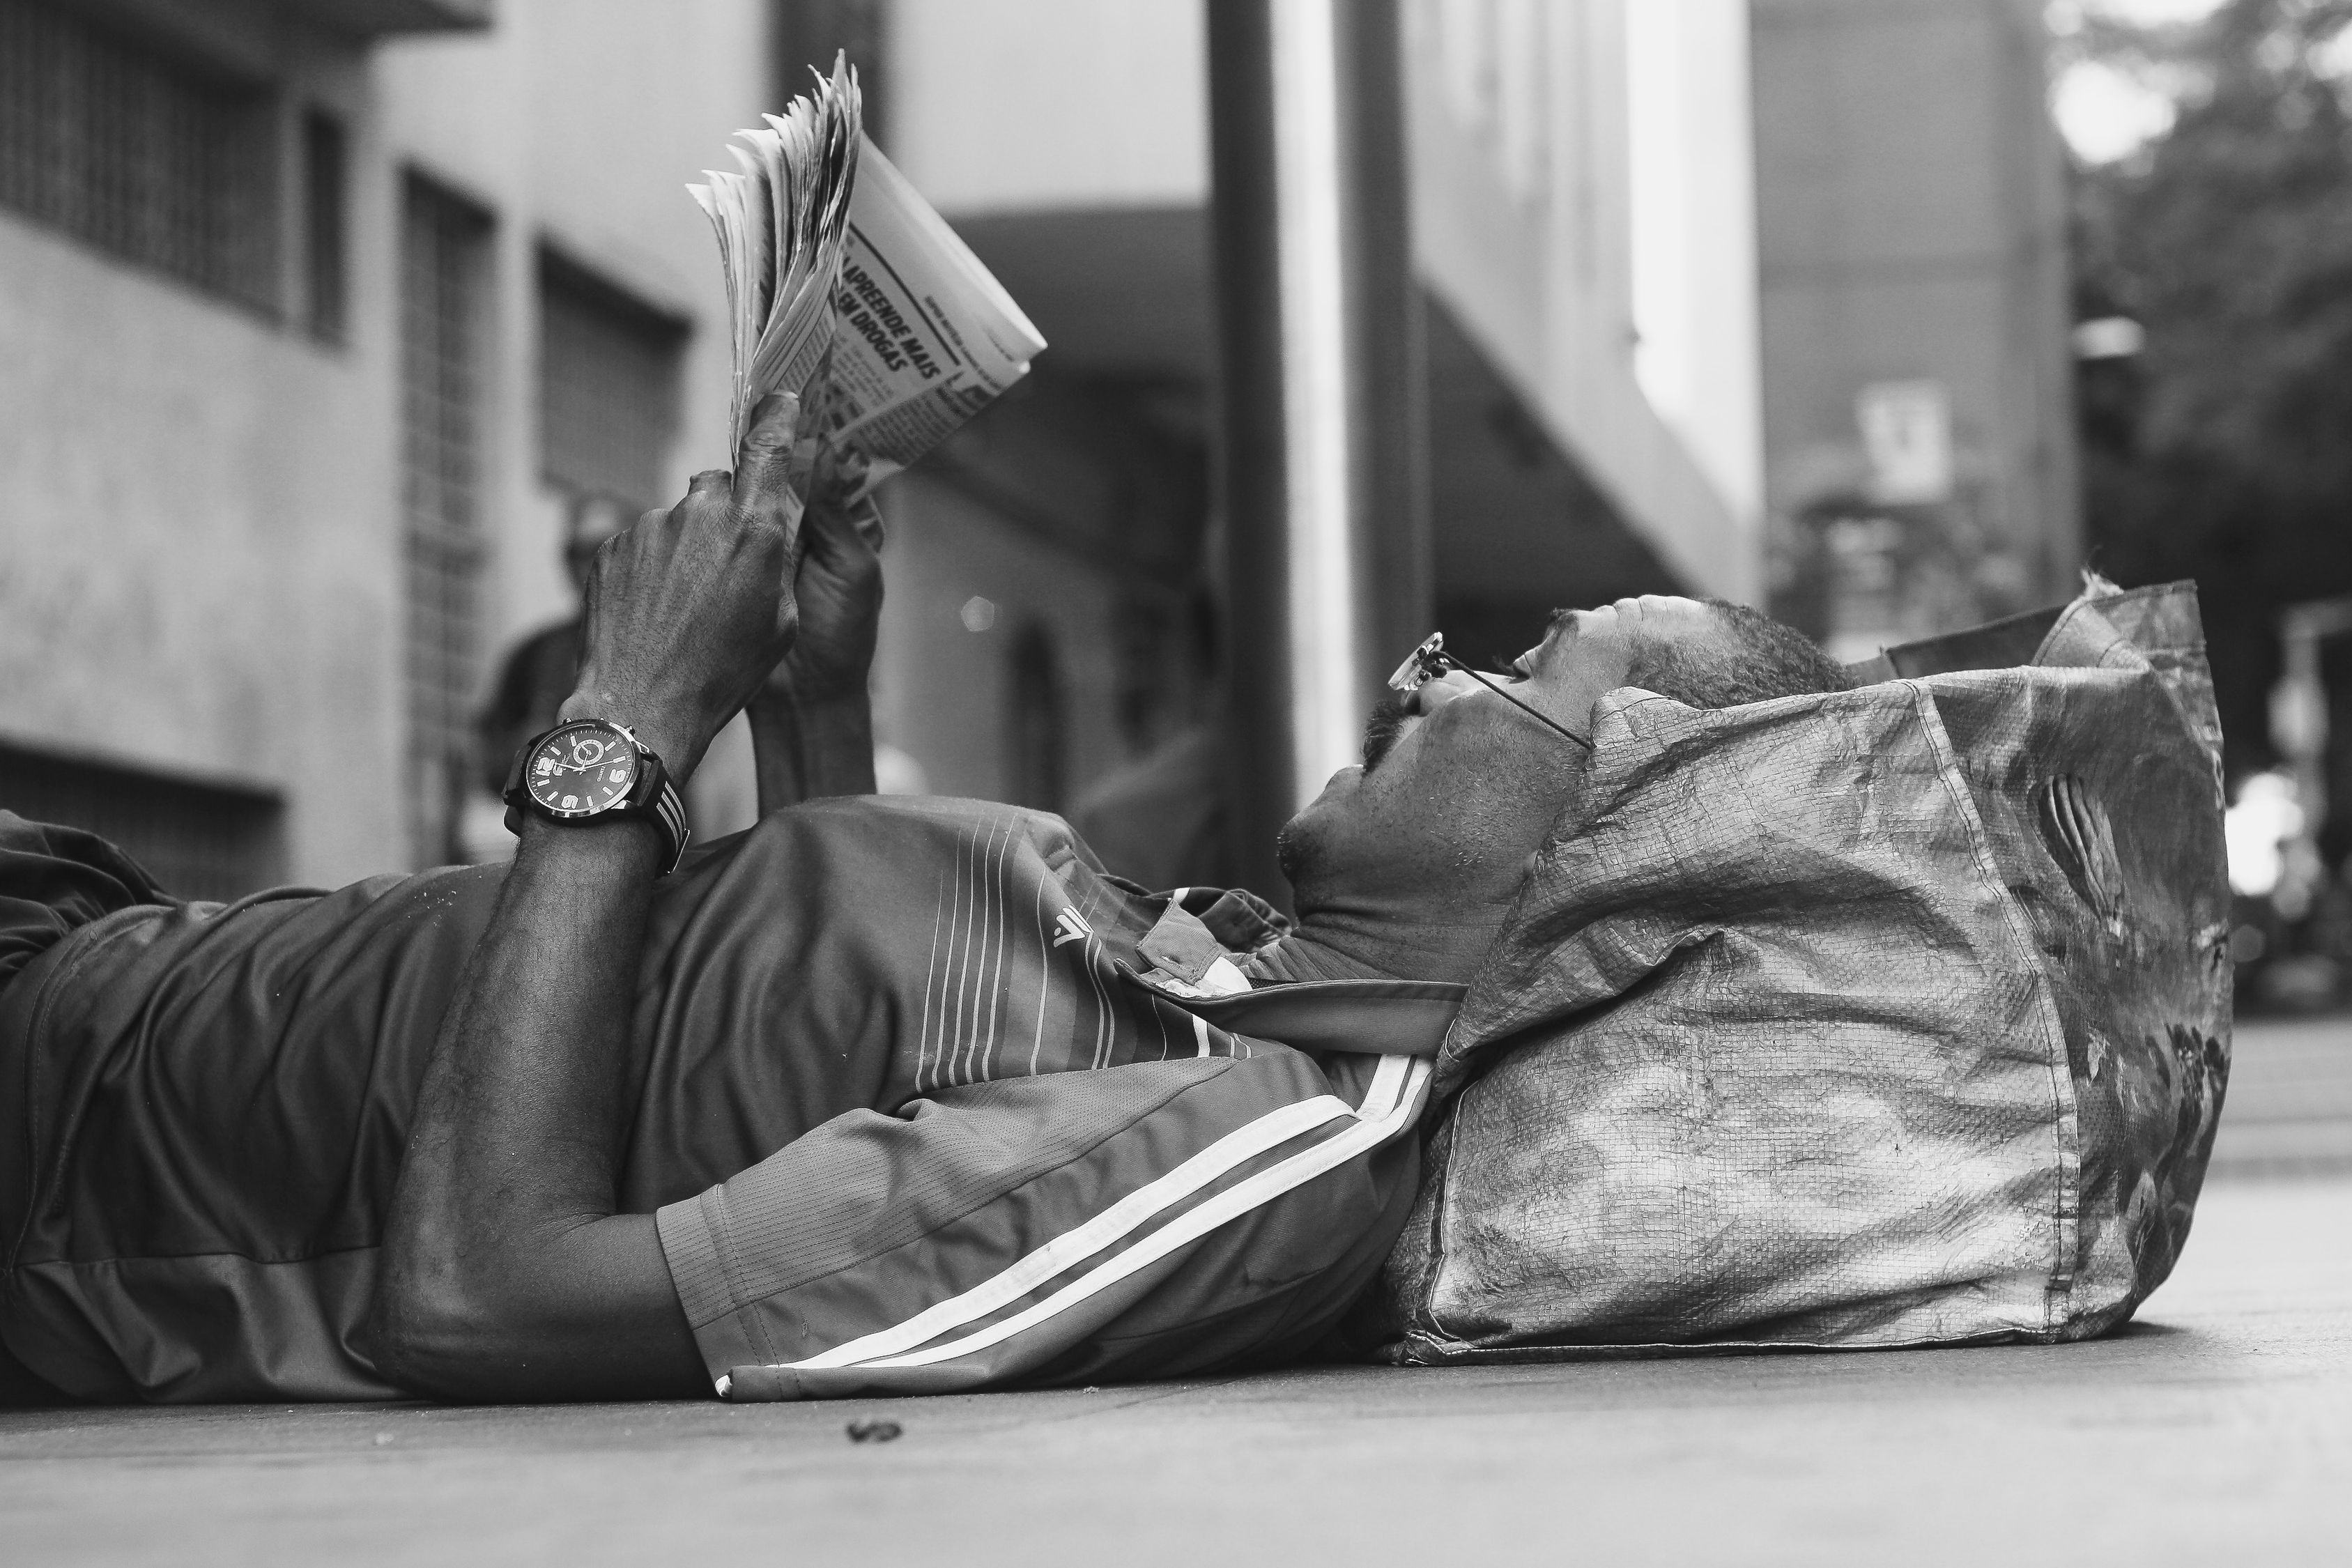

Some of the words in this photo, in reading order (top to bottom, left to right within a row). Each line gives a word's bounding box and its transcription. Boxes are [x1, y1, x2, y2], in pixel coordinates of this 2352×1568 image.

[843, 265, 912, 338] APREENDE
[900, 337, 941, 379] MAIS
[838, 292, 861, 317] EM
[850, 311, 909, 372] DROGAS
[535, 757, 556, 776] 12
[608, 768, 627, 783] 6
[560, 794, 579, 809] 9
